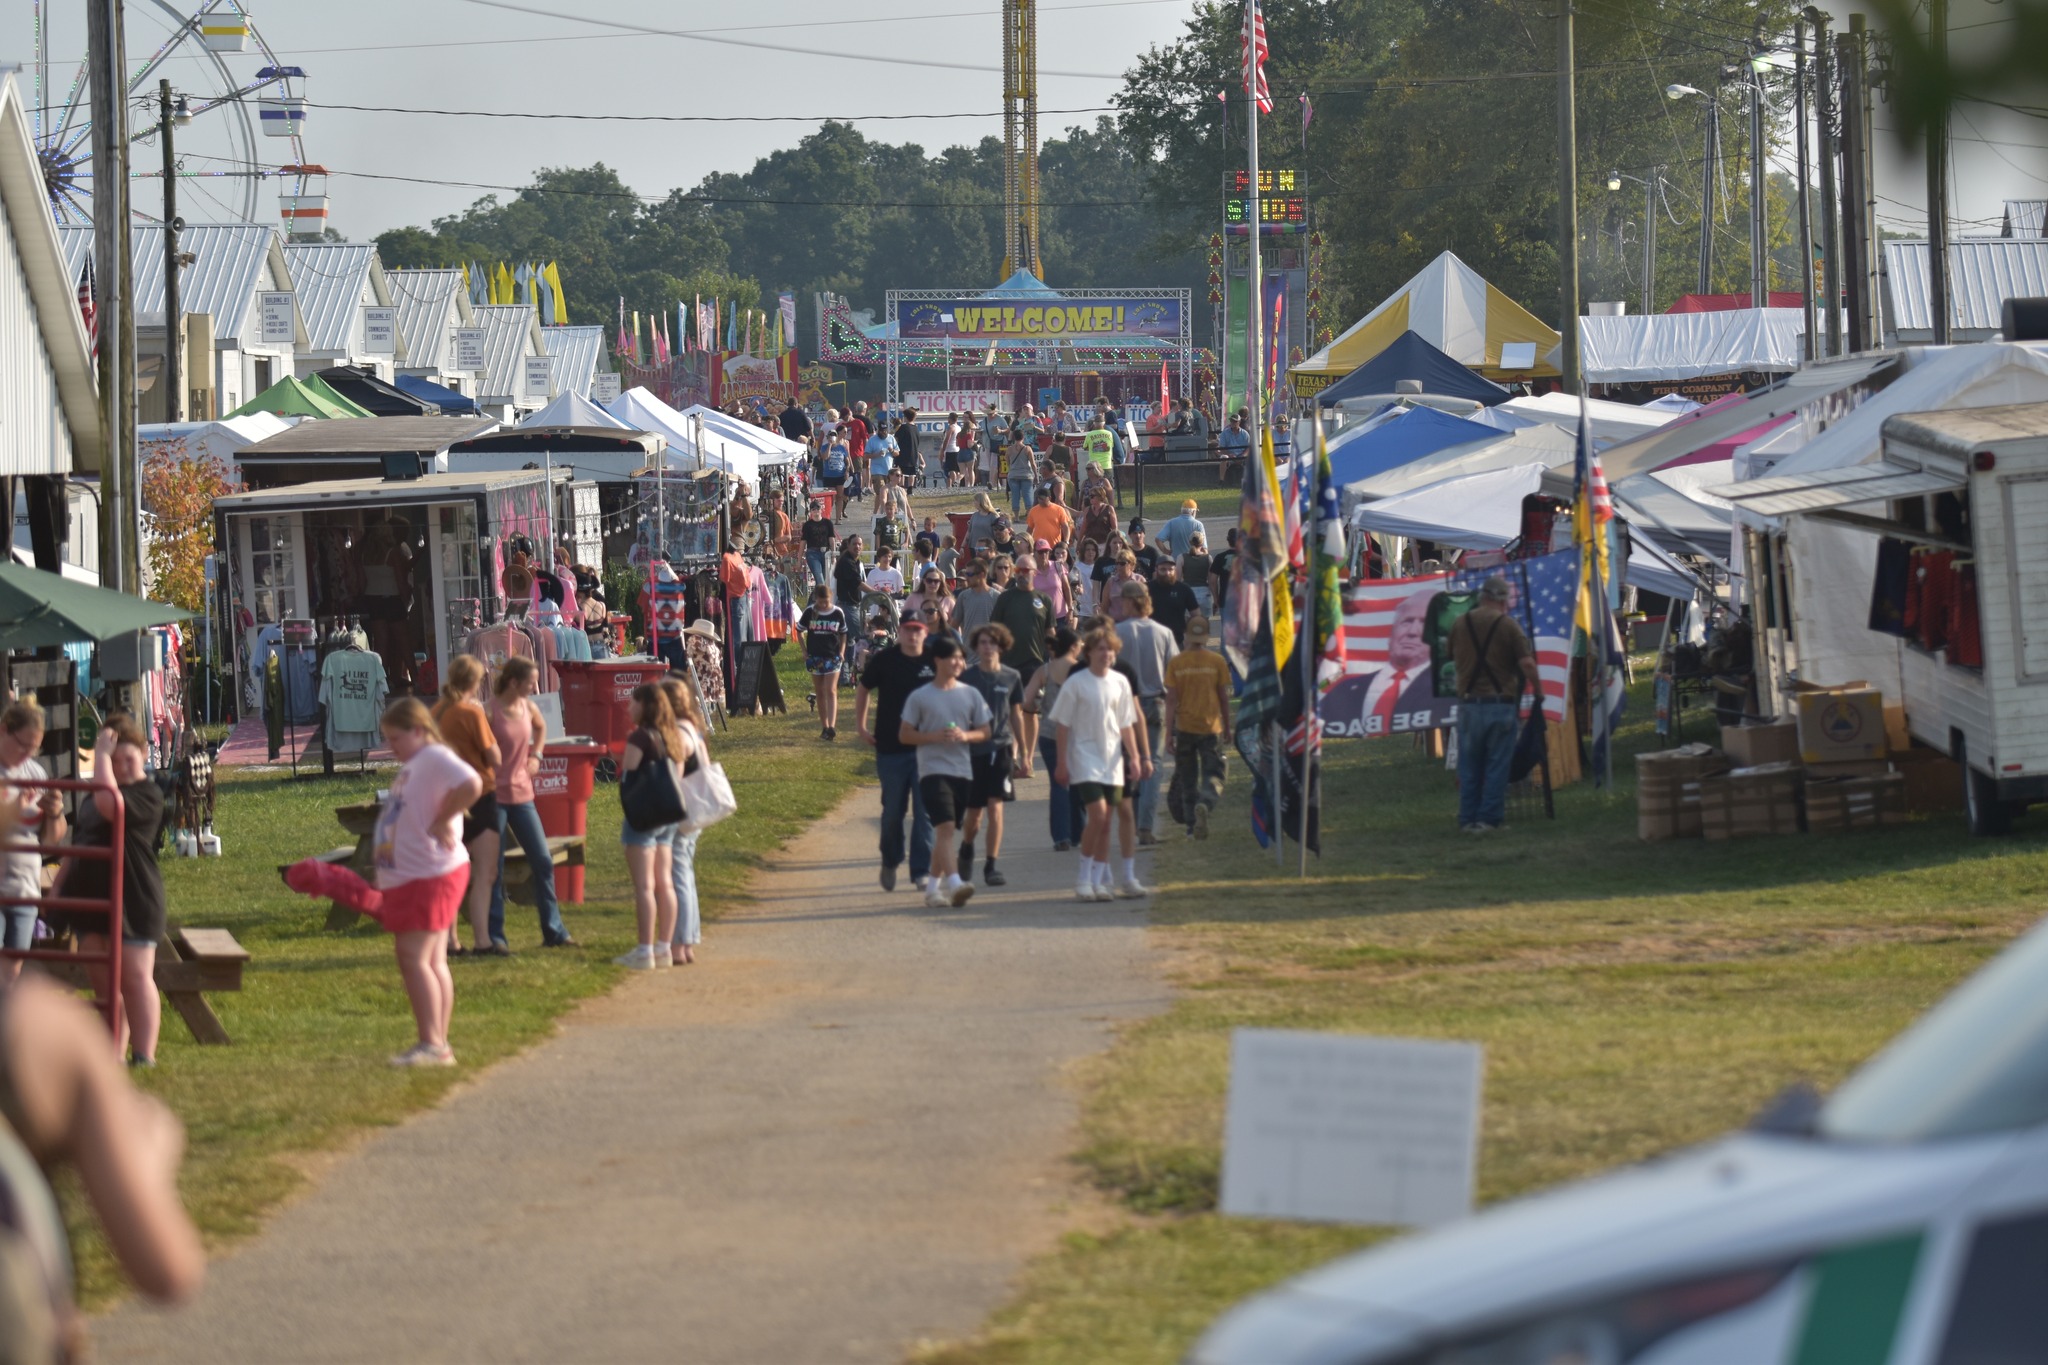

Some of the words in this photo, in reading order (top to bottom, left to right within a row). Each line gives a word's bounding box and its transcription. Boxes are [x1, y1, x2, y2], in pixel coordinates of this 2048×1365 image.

[1235, 170, 1294, 191] FUN
[924, 303, 944, 315] SHOW
[1147, 302, 1169, 316] SHOWS
[954, 306, 1125, 333] WELCOME!
[1297, 375, 1327, 387] TEXAS
[1647, 373, 1742, 385] ENDENT
[1296, 386, 1325, 398] BRISK
[1652, 387, 1679, 395] FIRE
[1682, 384, 1733, 394] COMPANY
[917, 395, 988, 413] TICKETS
[353, 670, 369, 678] LIKE
